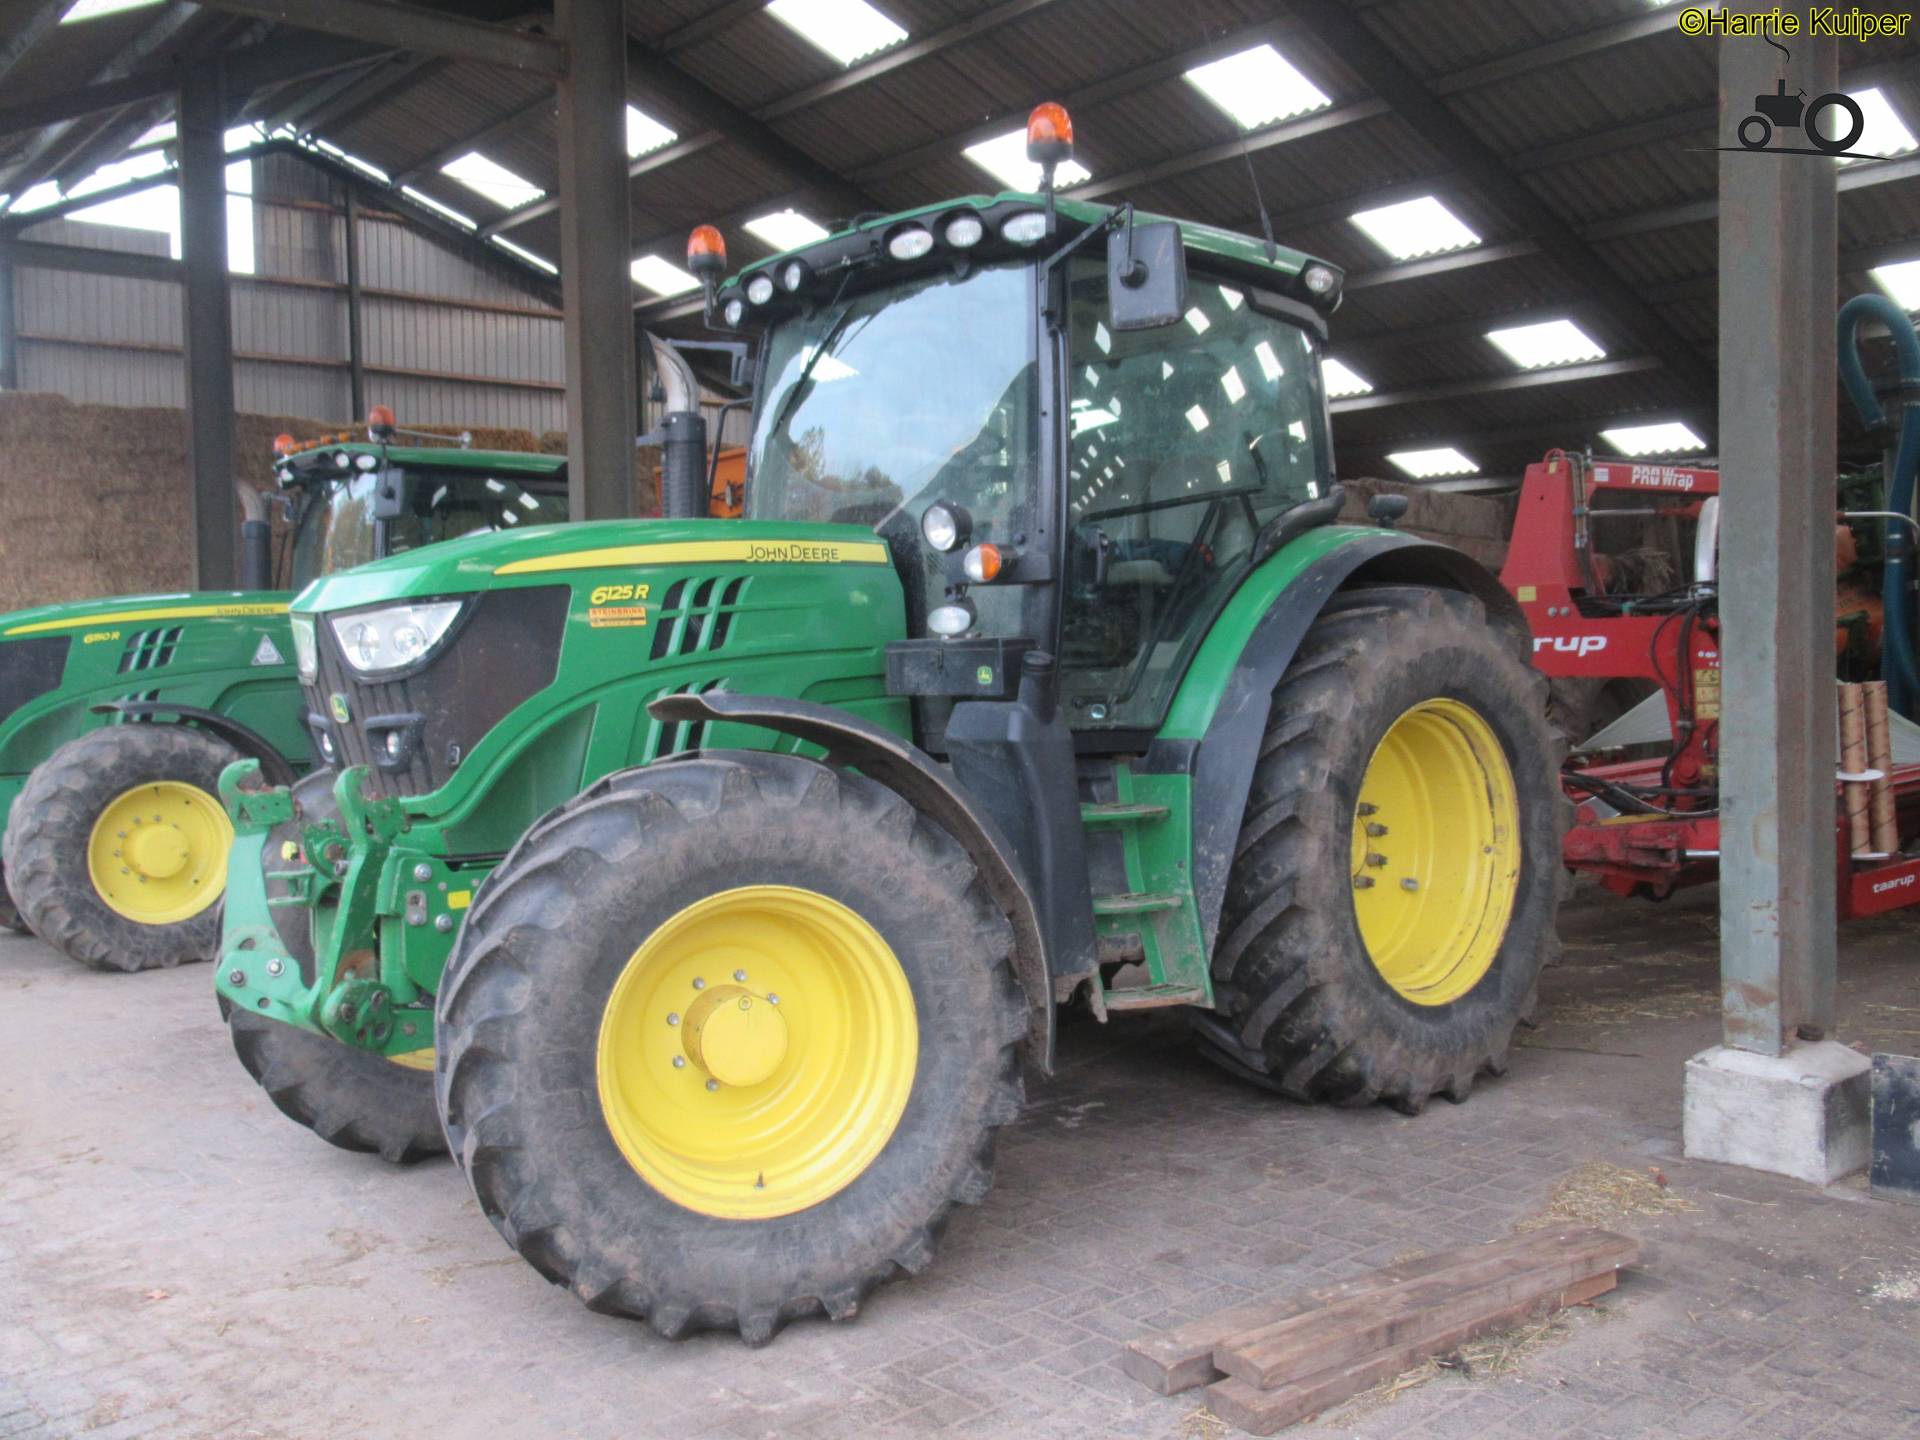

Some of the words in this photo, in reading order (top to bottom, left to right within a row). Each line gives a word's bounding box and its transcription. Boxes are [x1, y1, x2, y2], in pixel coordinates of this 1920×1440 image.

[1662, 467, 1694, 491] Wrap
[745, 544, 788, 560] JOHN
[790, 544, 839, 560] DEERE
[1533, 635, 1607, 657] rup
[1872, 874, 1915, 893] taarup
